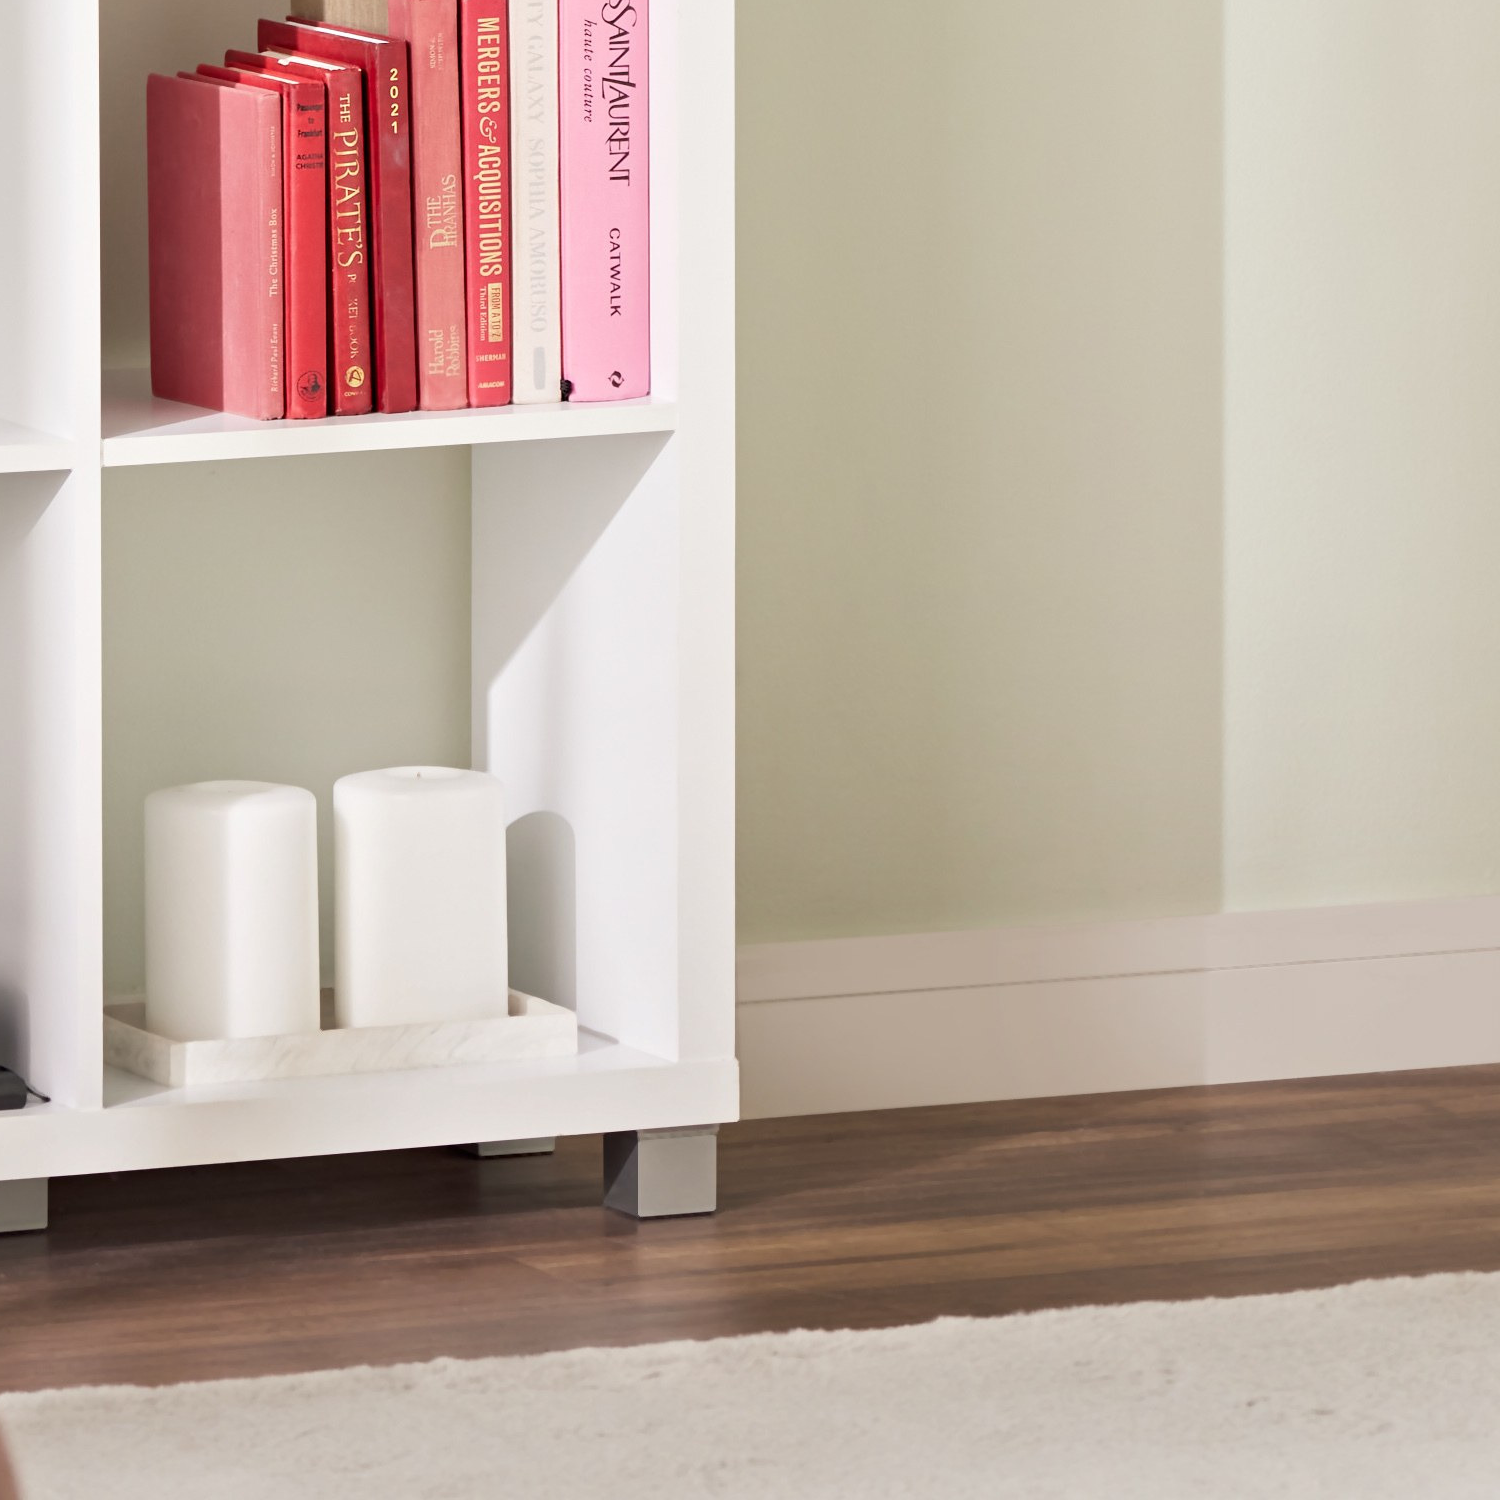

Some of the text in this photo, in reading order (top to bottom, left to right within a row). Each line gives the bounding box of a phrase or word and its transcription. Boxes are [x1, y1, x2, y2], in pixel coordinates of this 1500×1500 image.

[339, 93, 351, 123] THE
[389, 68, 399, 134] 2021
[527, 35, 545, 125] GALAXY
[583, 19, 597, 123] haute couture
[474, 17, 503, 276] MERGERS & ACQUISITIONS
[528, 138, 546, 220] SOPHIA
[333, 127, 363, 267] PIRATE'S
[427, 196, 442, 228] THE
[430, 174, 457, 249] PIRANHAS
[268, 209, 278, 297] The Christmas Box
[530, 227, 547, 333] AMORUSO
[609, 227, 622, 316] CATWALK
[491, 287, 501, 309] FROM
[492, 320, 501, 329] TO
[270, 323, 279, 392] Richard Paul Evans
[428, 330, 445, 375] Harold
[446, 325, 461, 377] Robbins
